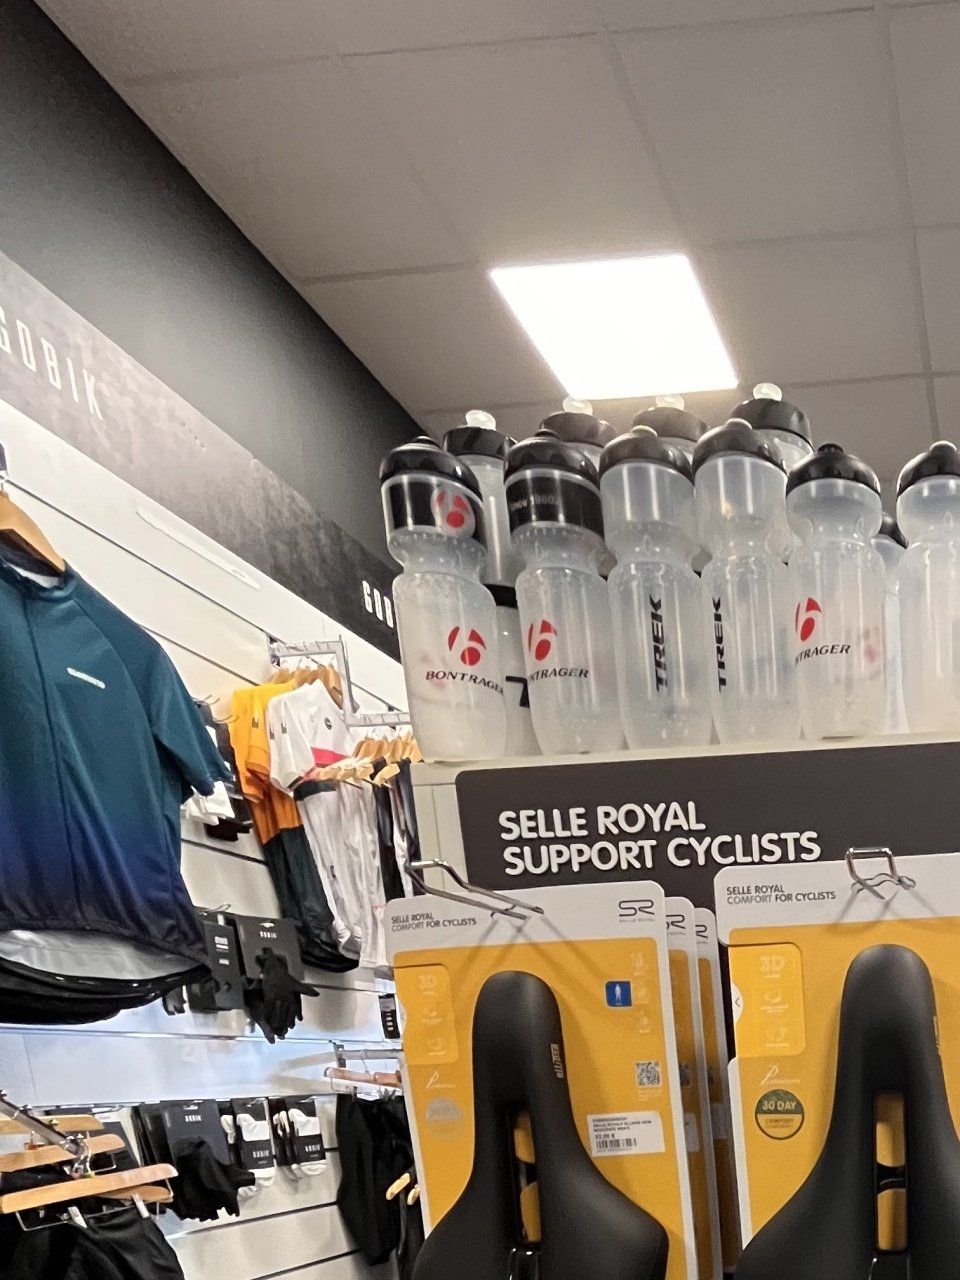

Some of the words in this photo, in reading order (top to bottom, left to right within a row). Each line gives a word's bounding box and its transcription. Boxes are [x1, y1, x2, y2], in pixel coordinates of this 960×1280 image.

[650, 594, 667, 693] TREK
[712, 596, 727, 693] TREK
[498, 807, 588, 841] SELLE
[596, 800, 707, 835] ROYAL
[503, 838, 657, 876] SUPPORT
[667, 830, 822, 868] CYCLISTS
[726, 885, 753, 896] SELLE
[755, 883, 785, 895] ROYAL
[727, 894, 773, 905] COMFORT
[775, 892, 794, 903] FOR
[795, 890, 837, 902] CYCLISTS
[391, 914, 410, 925] SELLE
[411, 911, 435, 922] ROYAL
[391, 921, 425, 933] COMFORT
[426, 920, 441, 929] FOR
[442, 917, 478, 928] CYCLISTS
[762, 1101, 776, 1111] 30
[777, 1100, 798, 1111] DAY
